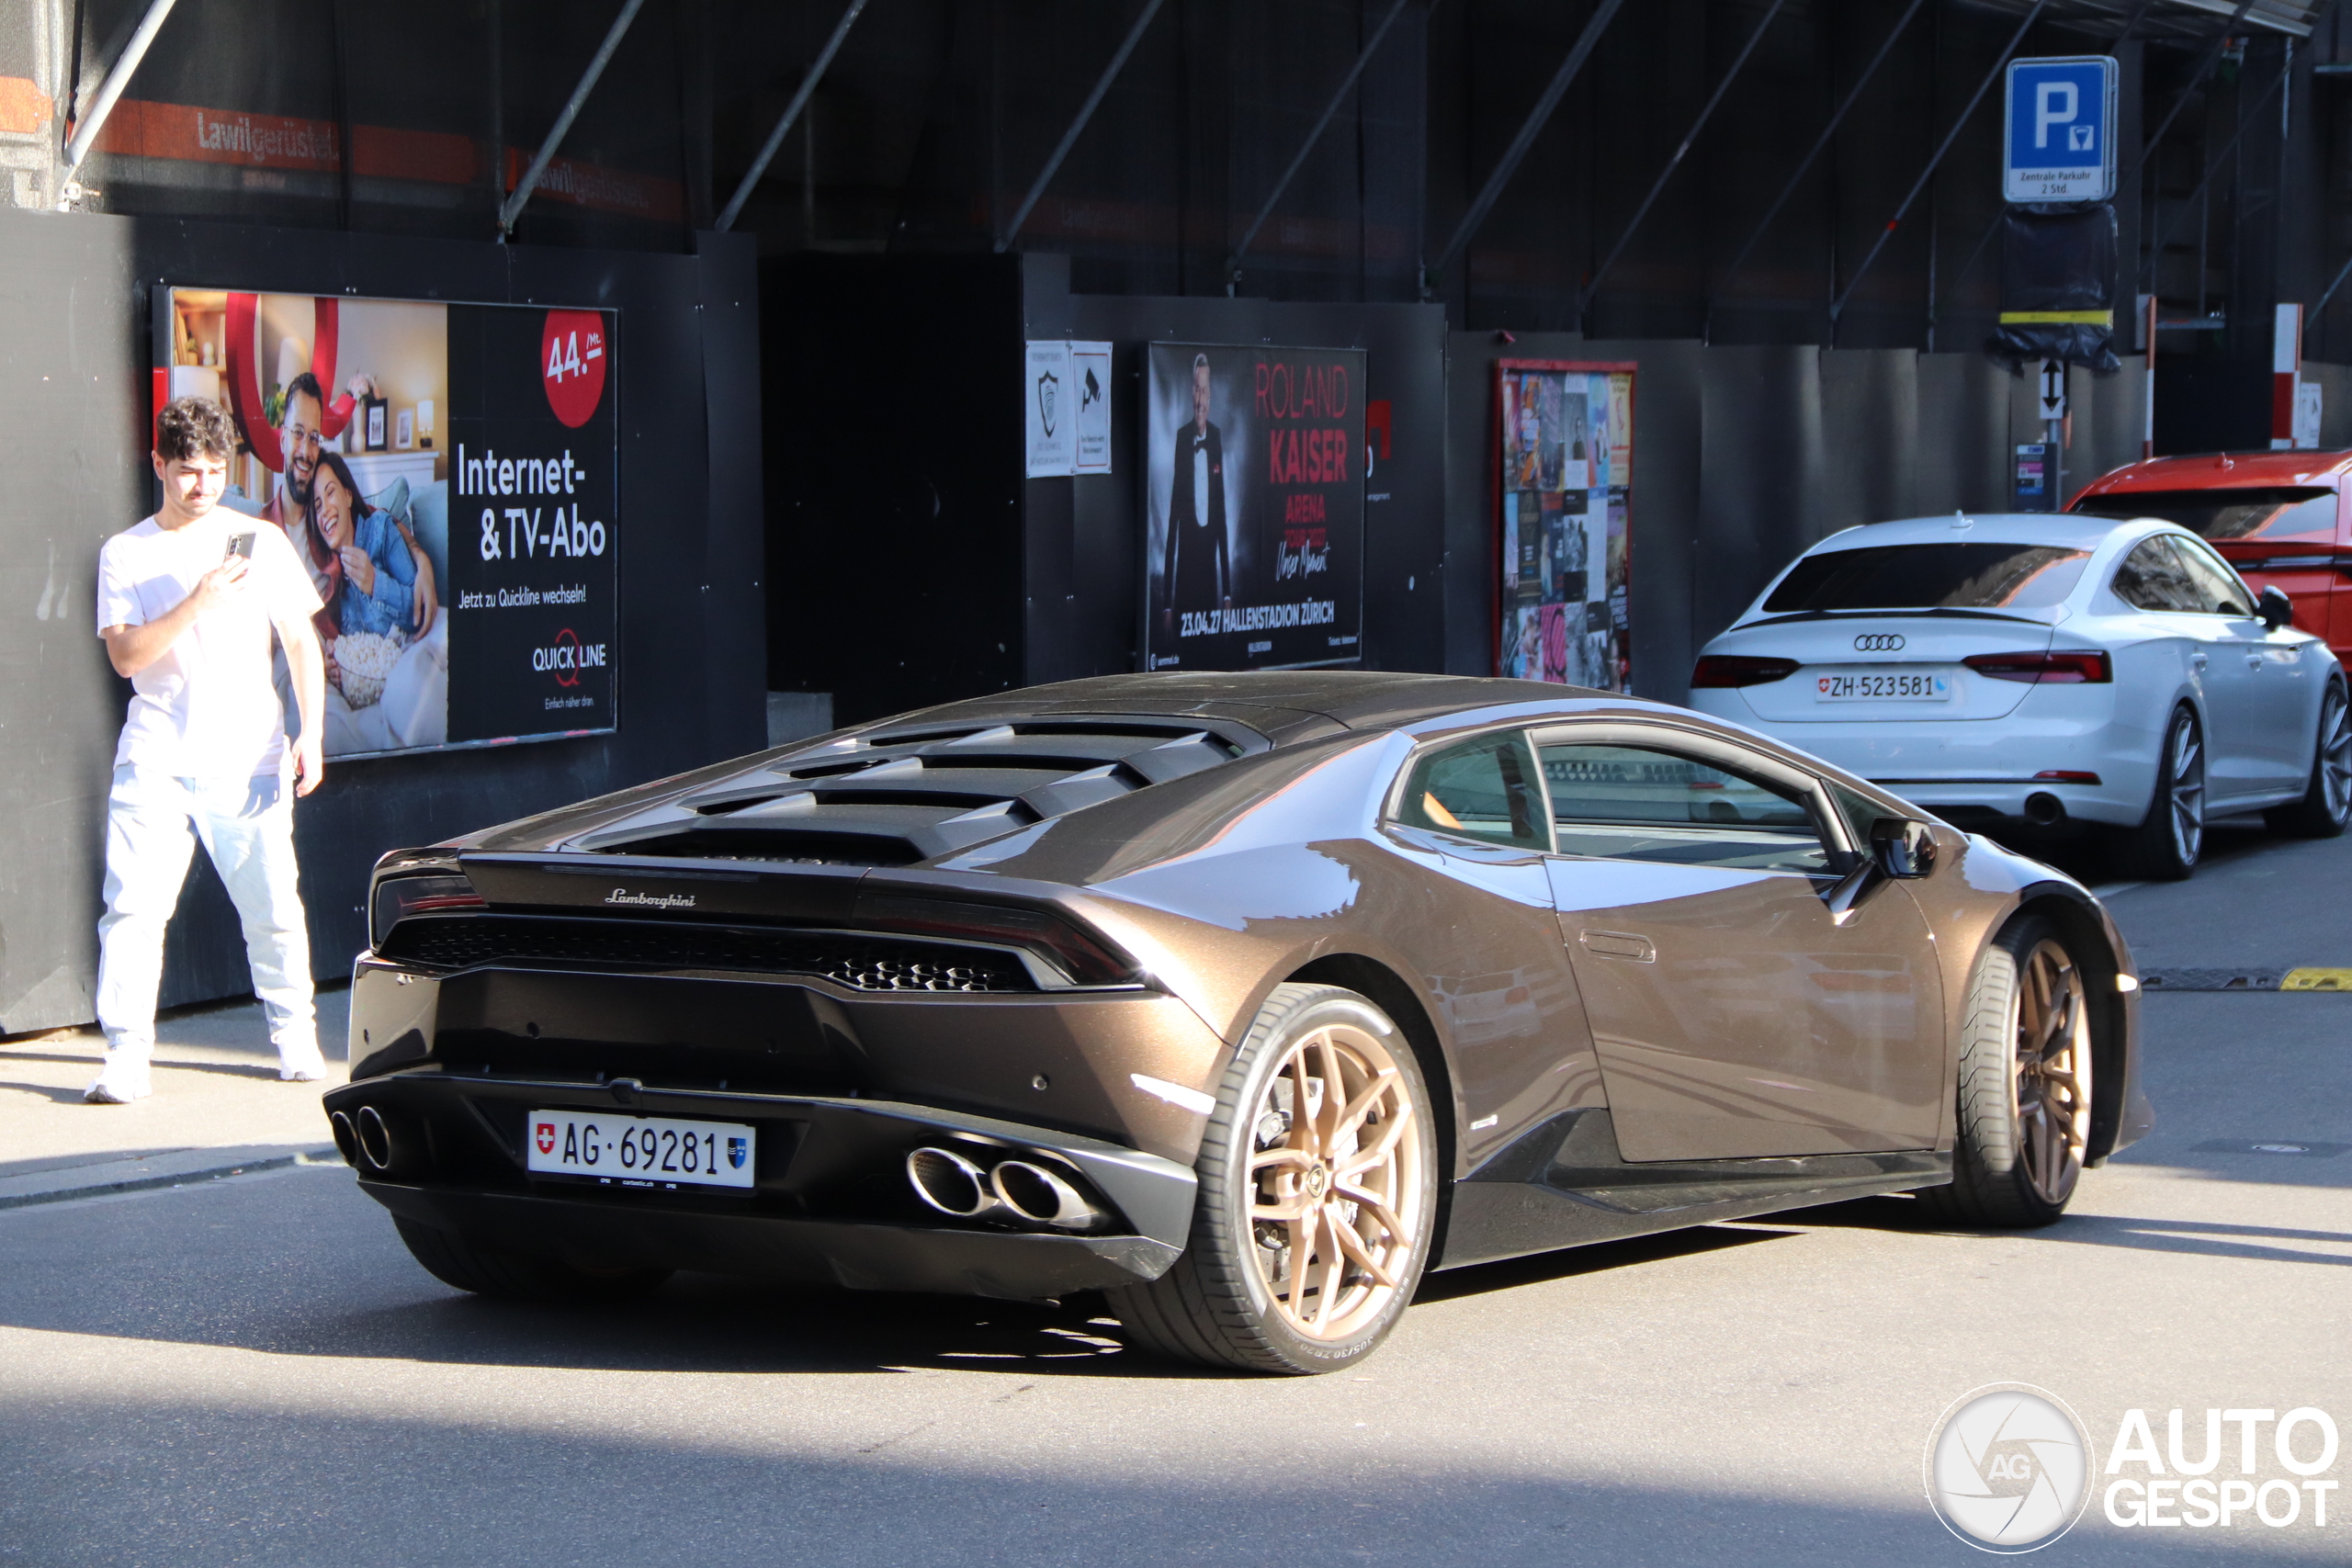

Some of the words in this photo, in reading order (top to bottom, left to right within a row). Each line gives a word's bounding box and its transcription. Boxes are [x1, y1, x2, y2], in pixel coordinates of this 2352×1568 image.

[2035, 82, 2078, 149] P
[2020, 172, 2055, 181] Zentrale
[2058, 171, 2091, 181] Parkuhr
[2041, 185, 2047, 194] 2
[2051, 184, 2069, 194] Std.
[1256, 363, 1349, 419] ROLAND
[458, 443, 585, 496] Internet-
[1270, 429, 1348, 484] KAISER
[1284, 494, 1326, 524] ARENA
[481, 508, 502, 561] &
[504, 502, 606, 559] TV-Abo
[458, 590, 483, 609] Jetzt
[485, 594, 496, 608] zu
[499, 585, 540, 608] Quickline
[542, 583, 586, 604] wechseln!
[1181, 610, 1222, 637] 23.04.27
[1223, 604, 1300, 633] HALLENSTADION
[1301, 597, 1335, 625] ZÜRICH
[545, 697, 564, 710] Einfach
[565, 696, 581, 708] näher
[605, 887, 696, 909] Lamborghini
